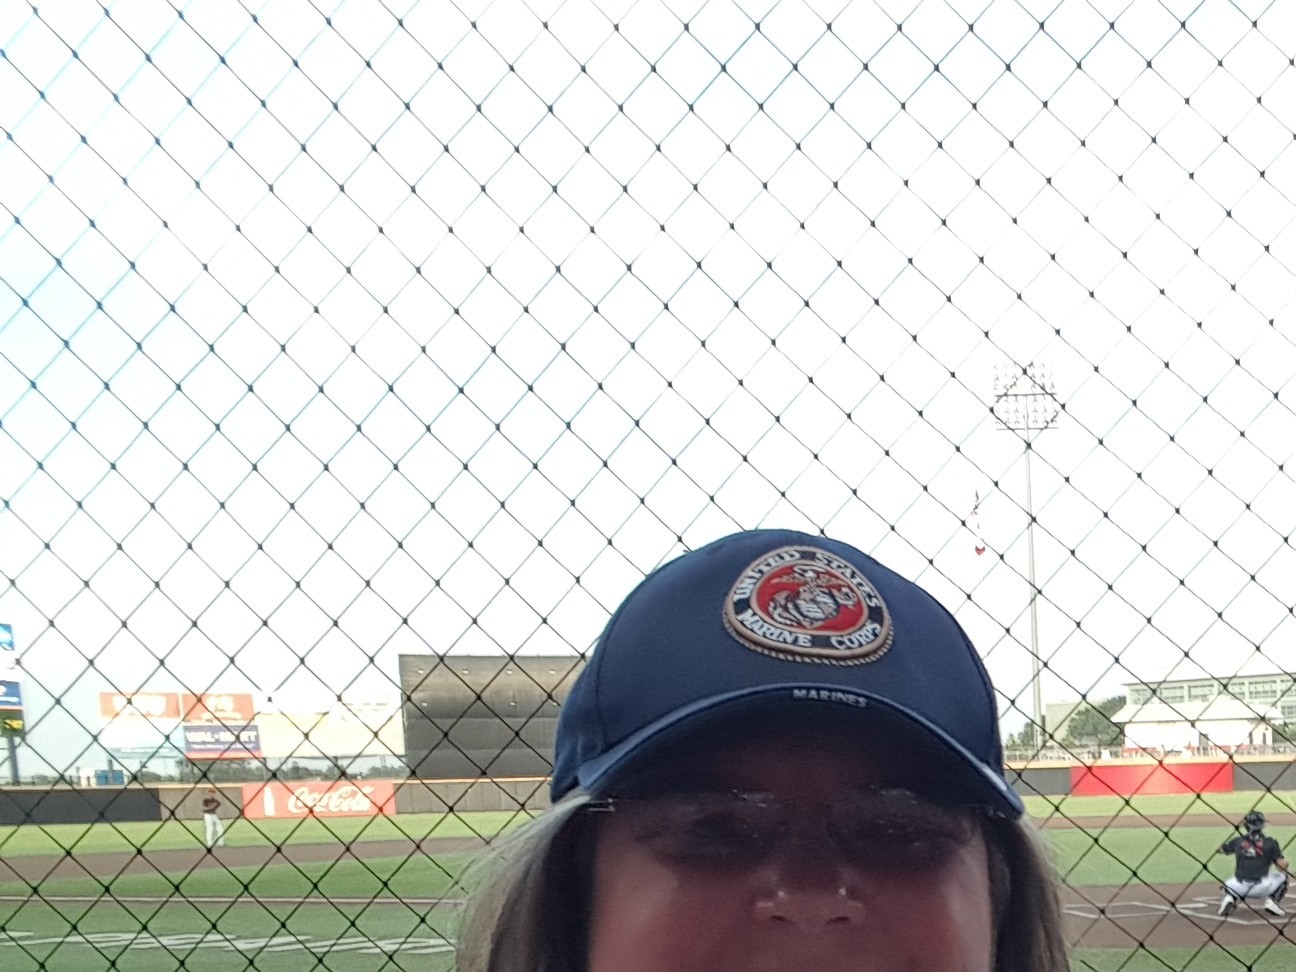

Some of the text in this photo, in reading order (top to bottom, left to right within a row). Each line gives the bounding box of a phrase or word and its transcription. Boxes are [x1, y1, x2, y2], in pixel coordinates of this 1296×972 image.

[733, 550, 880, 608] UNITED STATES
[737, 609, 882, 650] MARINE CORPS
[793, 689, 867, 707] MARINES
